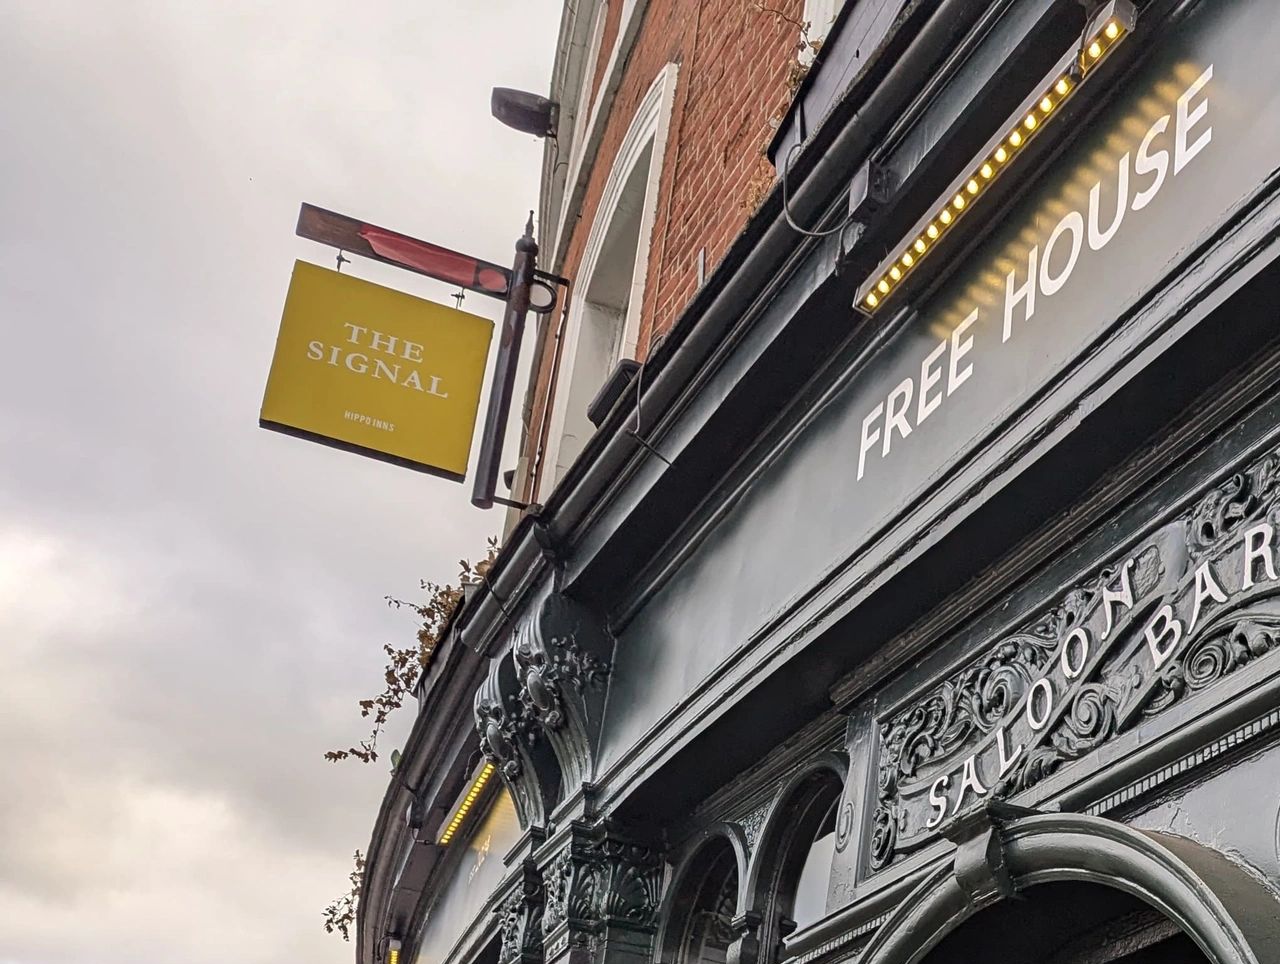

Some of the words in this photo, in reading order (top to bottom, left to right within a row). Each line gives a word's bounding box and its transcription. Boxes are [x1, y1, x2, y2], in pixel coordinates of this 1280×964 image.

[856, 306, 979, 482] FREE
[1002, 63, 1214, 344] HOUSE
[306, 341, 449, 399] SIGNAL
[343, 322, 425, 363] THE
[344, 410, 371, 425] HIPPO
[372, 419, 395, 432] INNS
[926, 558, 1135, 829] SALOON
[1143, 522, 1279, 671] BAR
